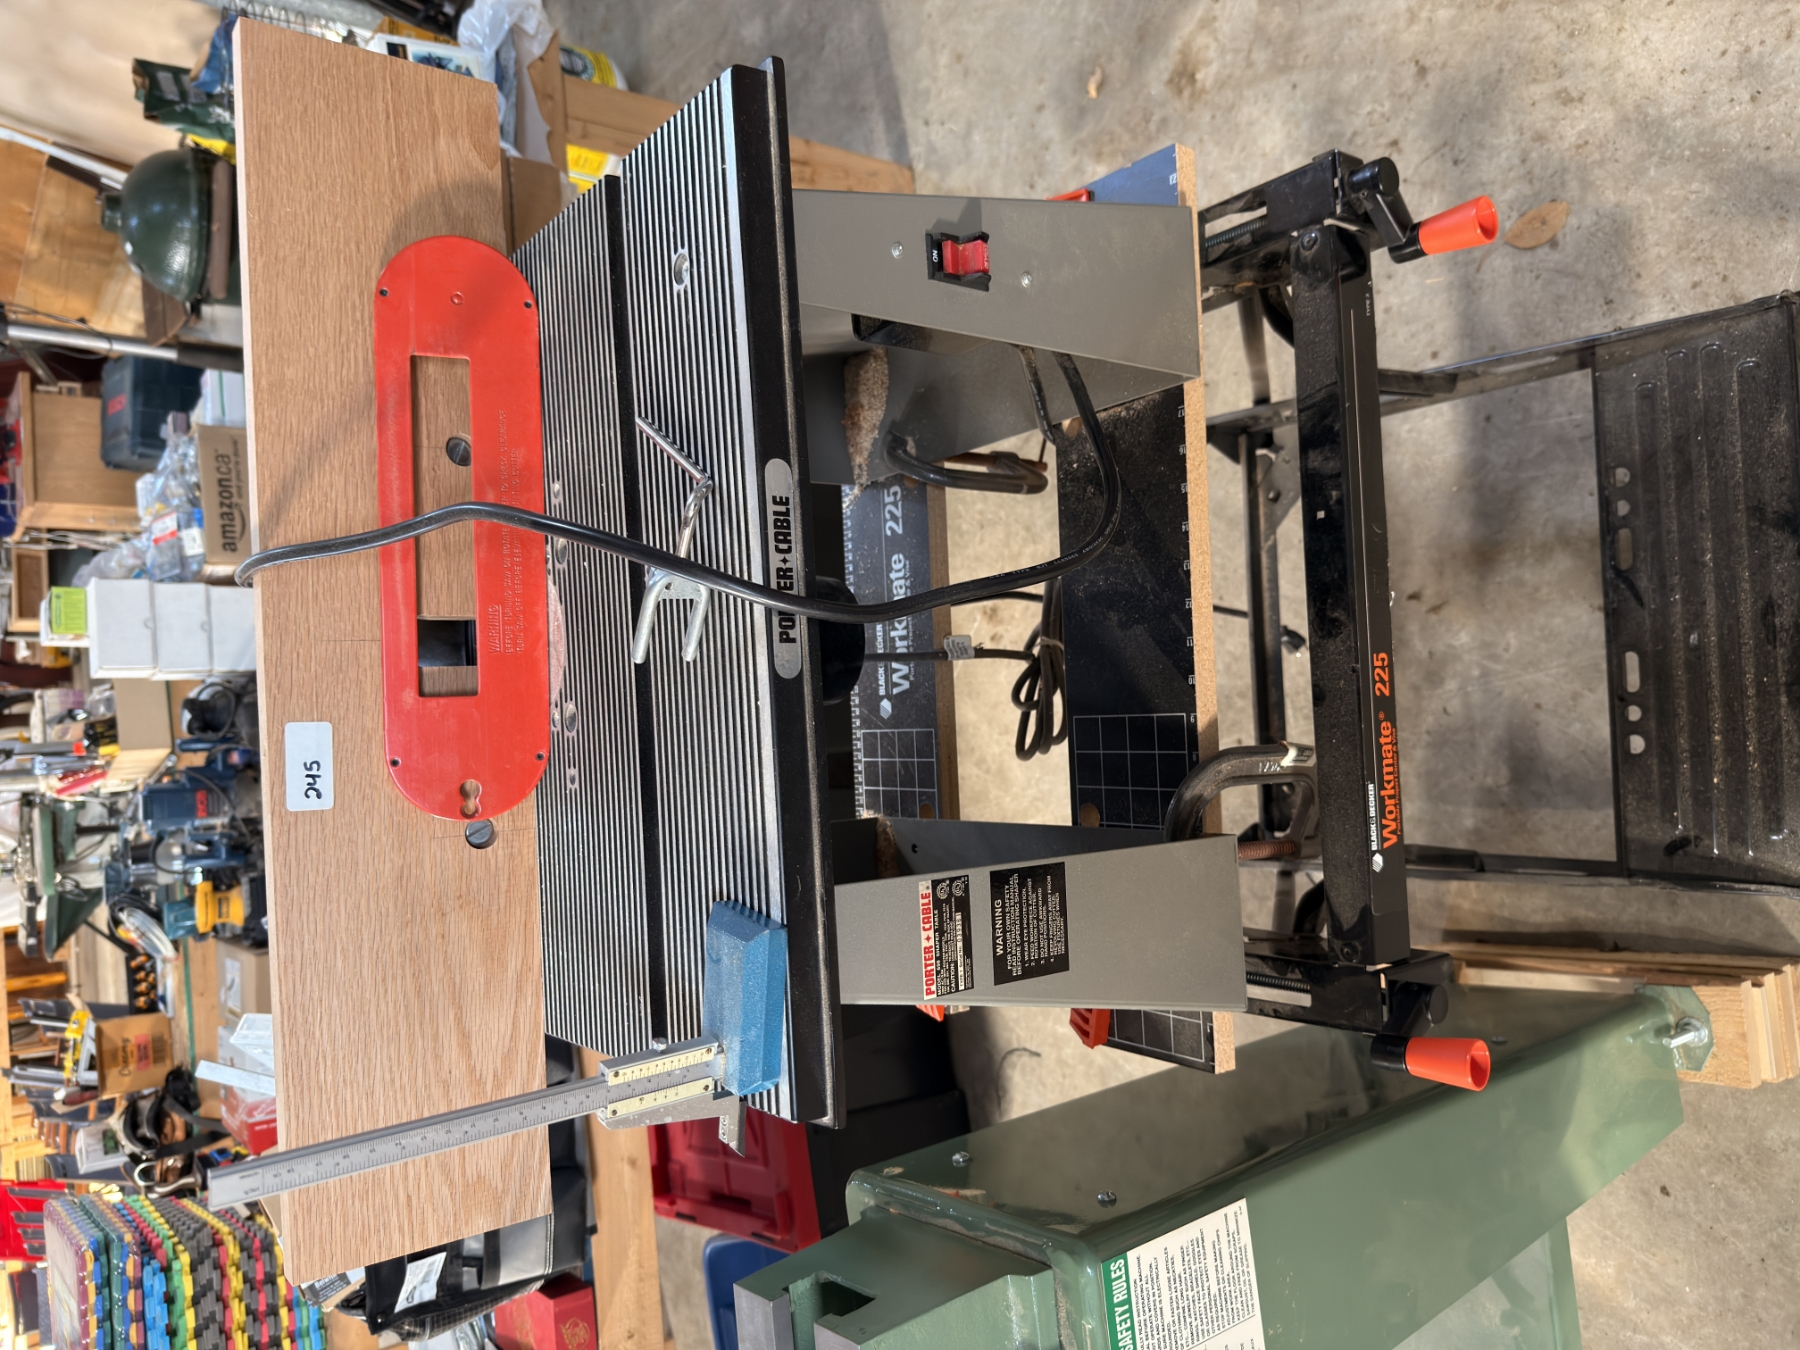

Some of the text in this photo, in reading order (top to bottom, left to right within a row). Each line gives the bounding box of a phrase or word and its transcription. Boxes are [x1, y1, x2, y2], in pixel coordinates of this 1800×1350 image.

[932, 250, 938, 262] ON
[772, 495, 796, 644] POER CABLE
[885, 485, 910, 694] Wrkate 225
[488, 605, 500, 653] WARNING
[1374, 652, 1389, 696] 225
[303, 760, 322, 799] 245
[921, 892, 935, 996] PORTER CABLE
[994, 899, 1003, 956] WARNING
[1110, 1259, 1128, 1303] RULES
